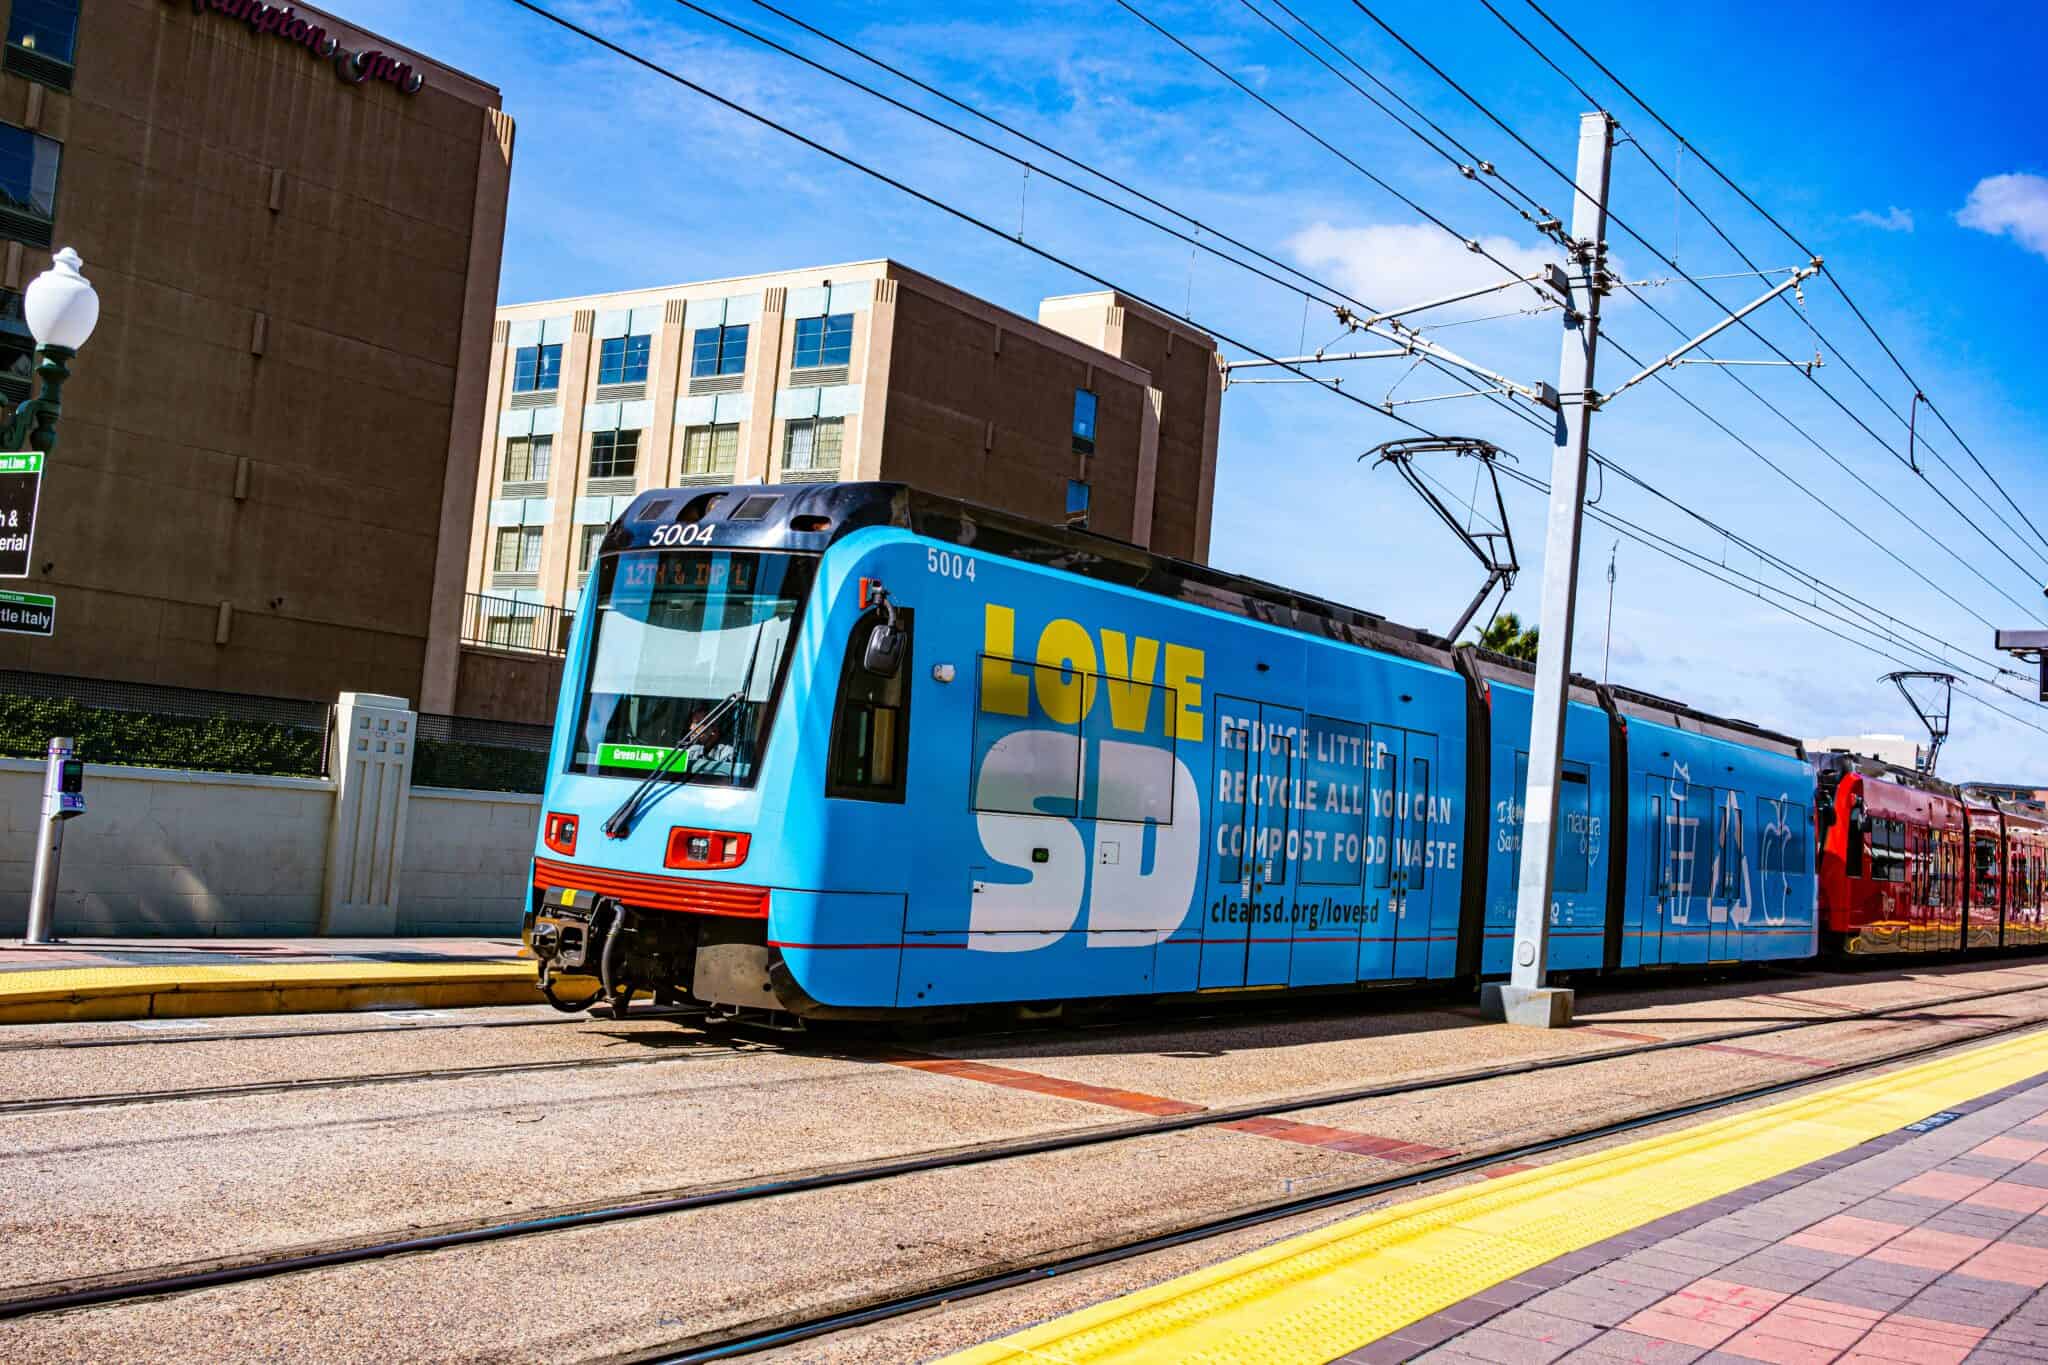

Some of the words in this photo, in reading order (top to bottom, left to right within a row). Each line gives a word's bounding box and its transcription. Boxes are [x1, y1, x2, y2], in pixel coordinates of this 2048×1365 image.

[193, 0, 339, 56] ampton
[338, 48, 424, 94] Inn
[8, 509, 18, 528] &
[649, 523, 714, 546] 5004
[0, 533, 28, 551] erial
[927, 547, 977, 583] 5004
[21, 609, 51, 630] Italy
[980, 602, 1206, 743] LOVE
[613, 748, 635, 760] Green
[635, 750, 654, 762] Line
[1220, 714, 1309, 759] REDUCE
[1317, 730, 1388, 771] LITTER
[1219, 769, 1318, 811] RECYCLE
[1324, 782, 1363, 816] ALL
[1372, 788, 1409, 821] YOU
[1413, 792, 1452, 825] CAN
[967, 729, 1201, 953] SD
[1216, 823, 1327, 862] COMPOST
[1333, 831, 1387, 865] FOOD
[1395, 837, 1457, 870] WASTE
[1211, 894, 1380, 931] cleansd.org/lovesd
